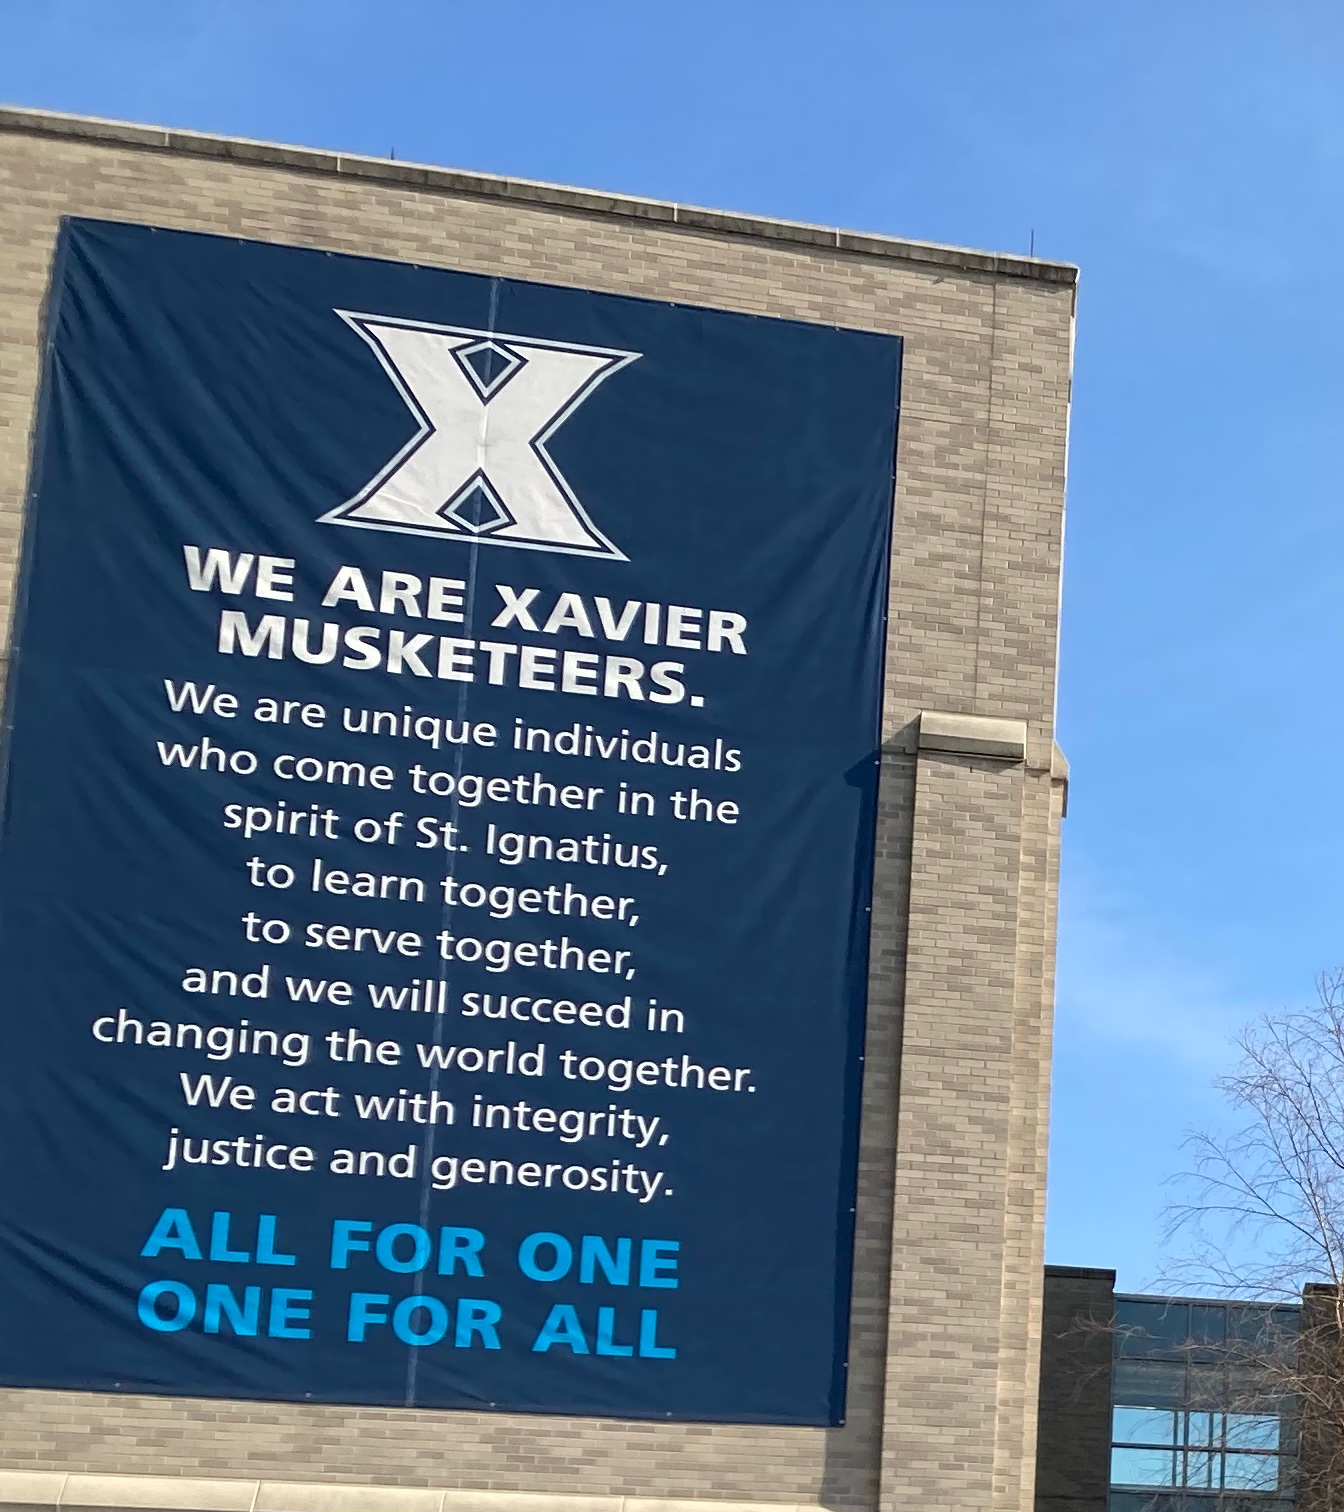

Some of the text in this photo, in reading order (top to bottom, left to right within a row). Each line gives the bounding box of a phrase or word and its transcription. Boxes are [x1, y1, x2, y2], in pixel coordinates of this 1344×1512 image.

[315, 308, 644, 562] X
[183, 545, 748, 656] WE ARE XAVIER
[218, 610, 706, 708] MUSKETEERS.
[163, 679, 741, 772] We are unique individuals
[156, 736, 740, 824] who come together in the
[223, 800, 668, 876] spirit of St. Ignatius,
[245, 856, 639, 927] to learn together,
[241, 911, 636, 981] to serve together,
[182, 964, 684, 1033] and we will succeed in
[92, 1008, 756, 1093] changing the world together.
[179, 1072, 670, 1148] We act with integrity,
[161, 1127, 673, 1204] justice and generosity.
[140, 1208, 680, 1289] ALL FOR ONE
[137, 1280, 676, 1359] ONE FOR ALL
